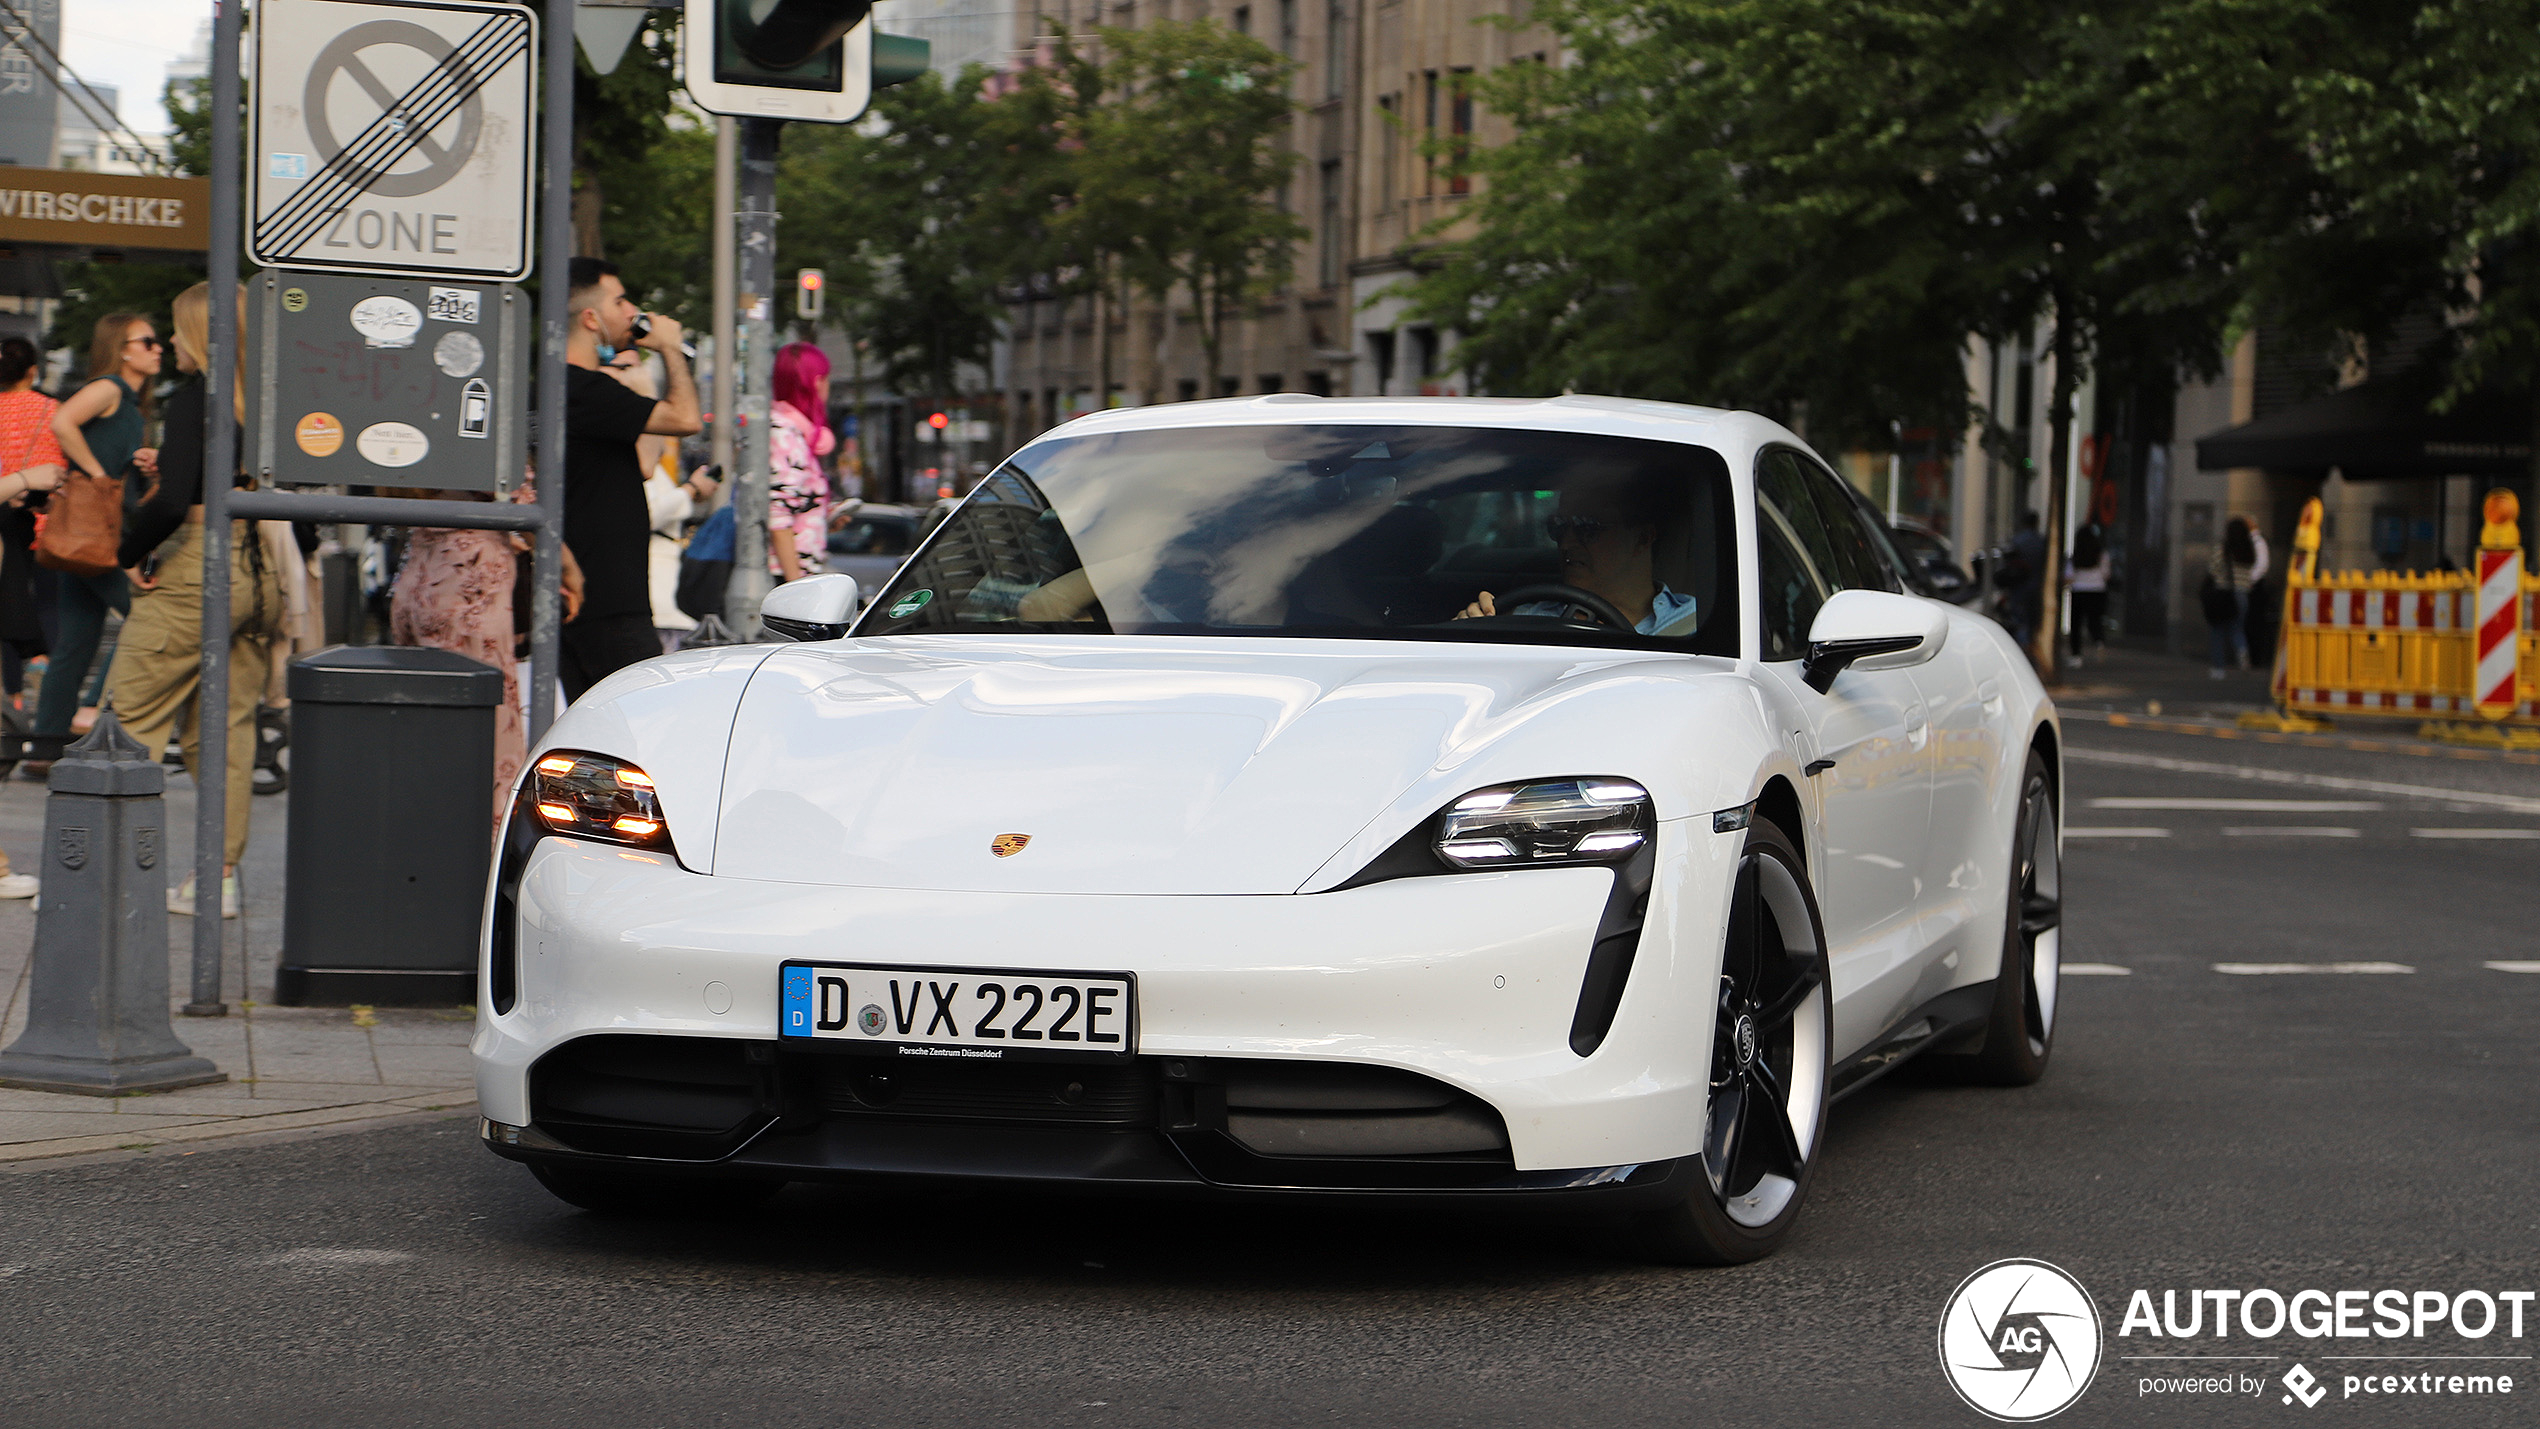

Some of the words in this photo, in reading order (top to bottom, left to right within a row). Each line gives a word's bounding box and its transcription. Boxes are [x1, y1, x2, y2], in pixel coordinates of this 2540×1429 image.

[324, 207, 458, 254] ZONE
[792, 1011, 803, 1026] D
[816, 976, 848, 1031] D
[889, 979, 959, 1036] VX
[974, 984, 1120, 1043] 222E
[899, 1046, 929, 1055] Porsche
[929, 1047, 960, 1056] Zentrum
[961, 1048, 1003, 1058] Düsseldorf
